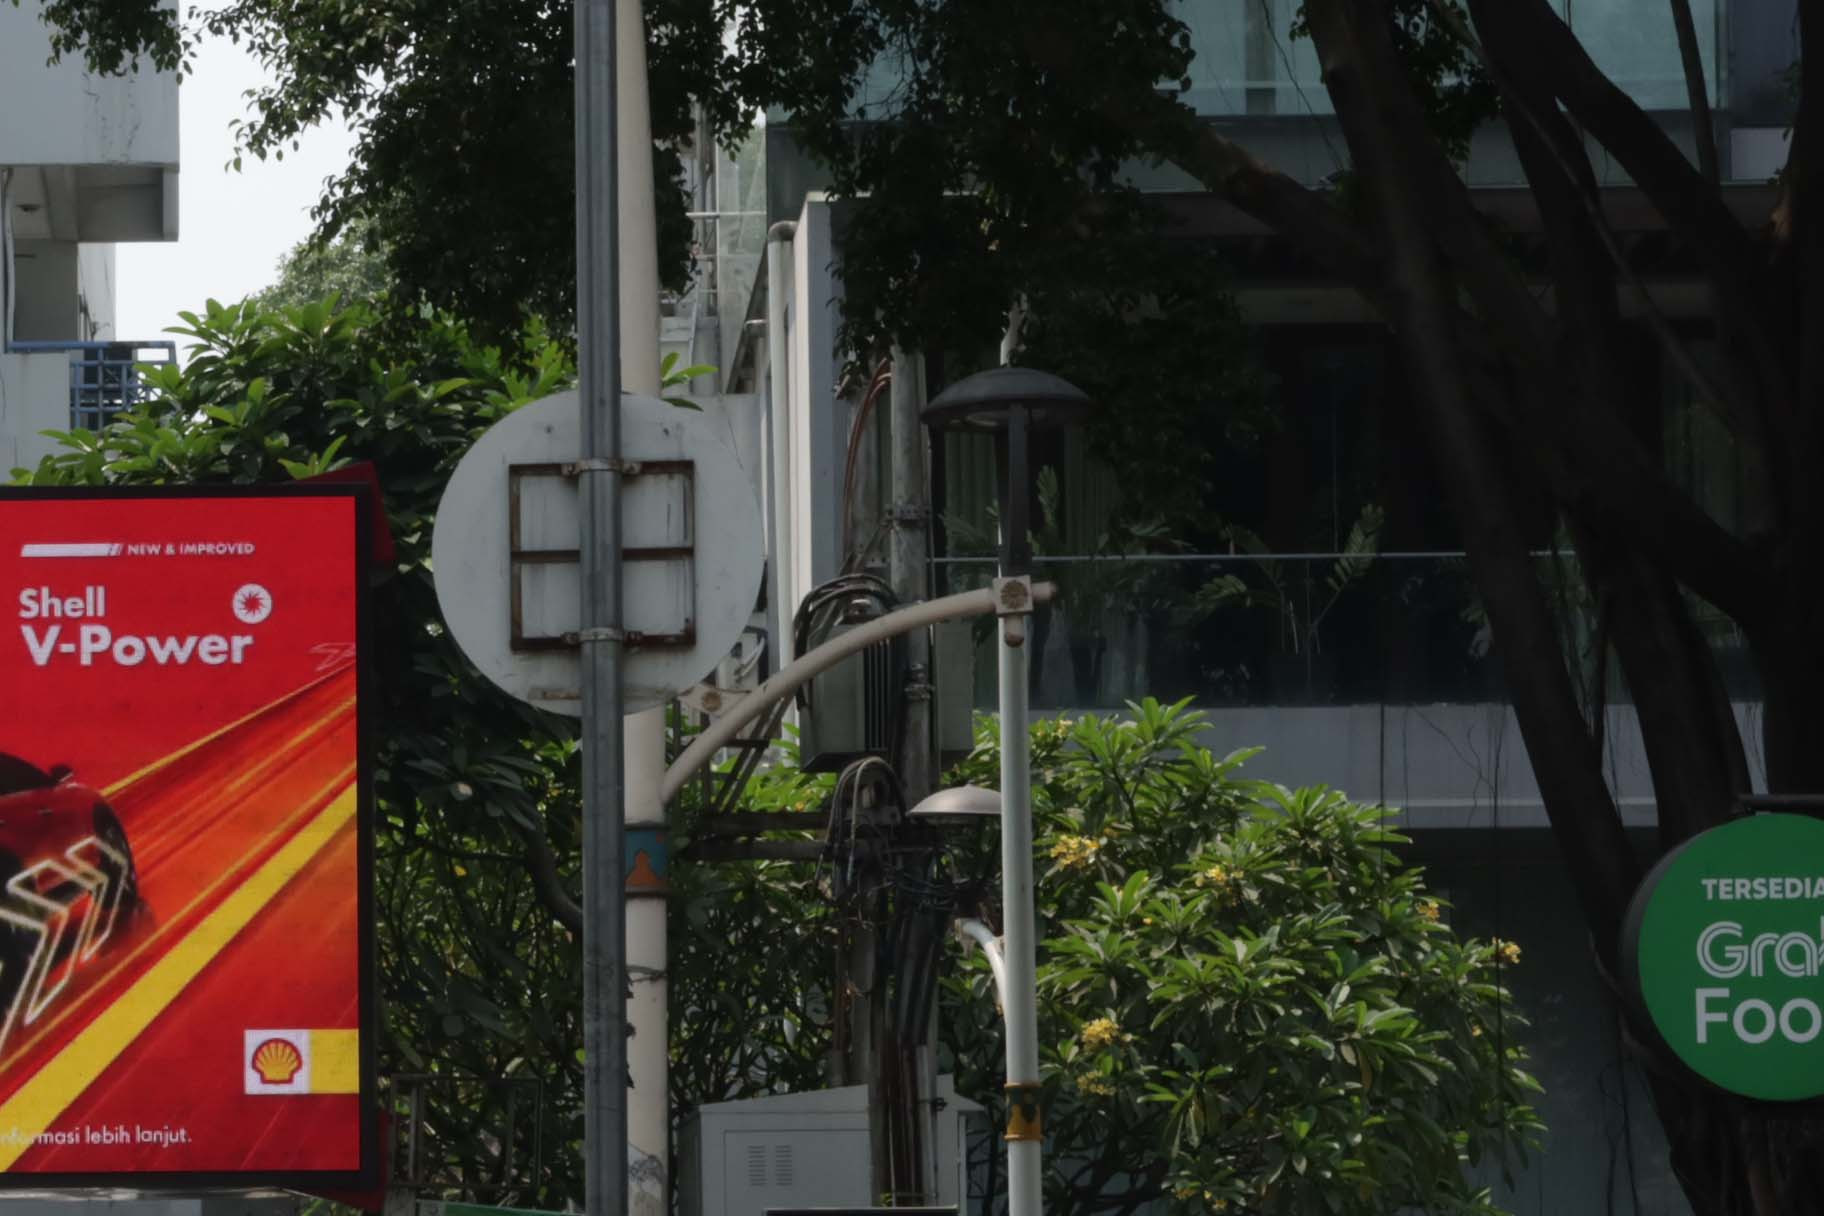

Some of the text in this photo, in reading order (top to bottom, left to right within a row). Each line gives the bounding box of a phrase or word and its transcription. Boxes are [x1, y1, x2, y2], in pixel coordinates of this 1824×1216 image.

[127, 542, 256, 556] NEW & IMPROVED
[18, 585, 105, 619] Shell
[20, 625, 253, 667] V-Power
[1696, 915, 1824, 979] Gra
[85, 1124, 131, 1145] lebih
[135, 1124, 193, 1149] lanjut.
